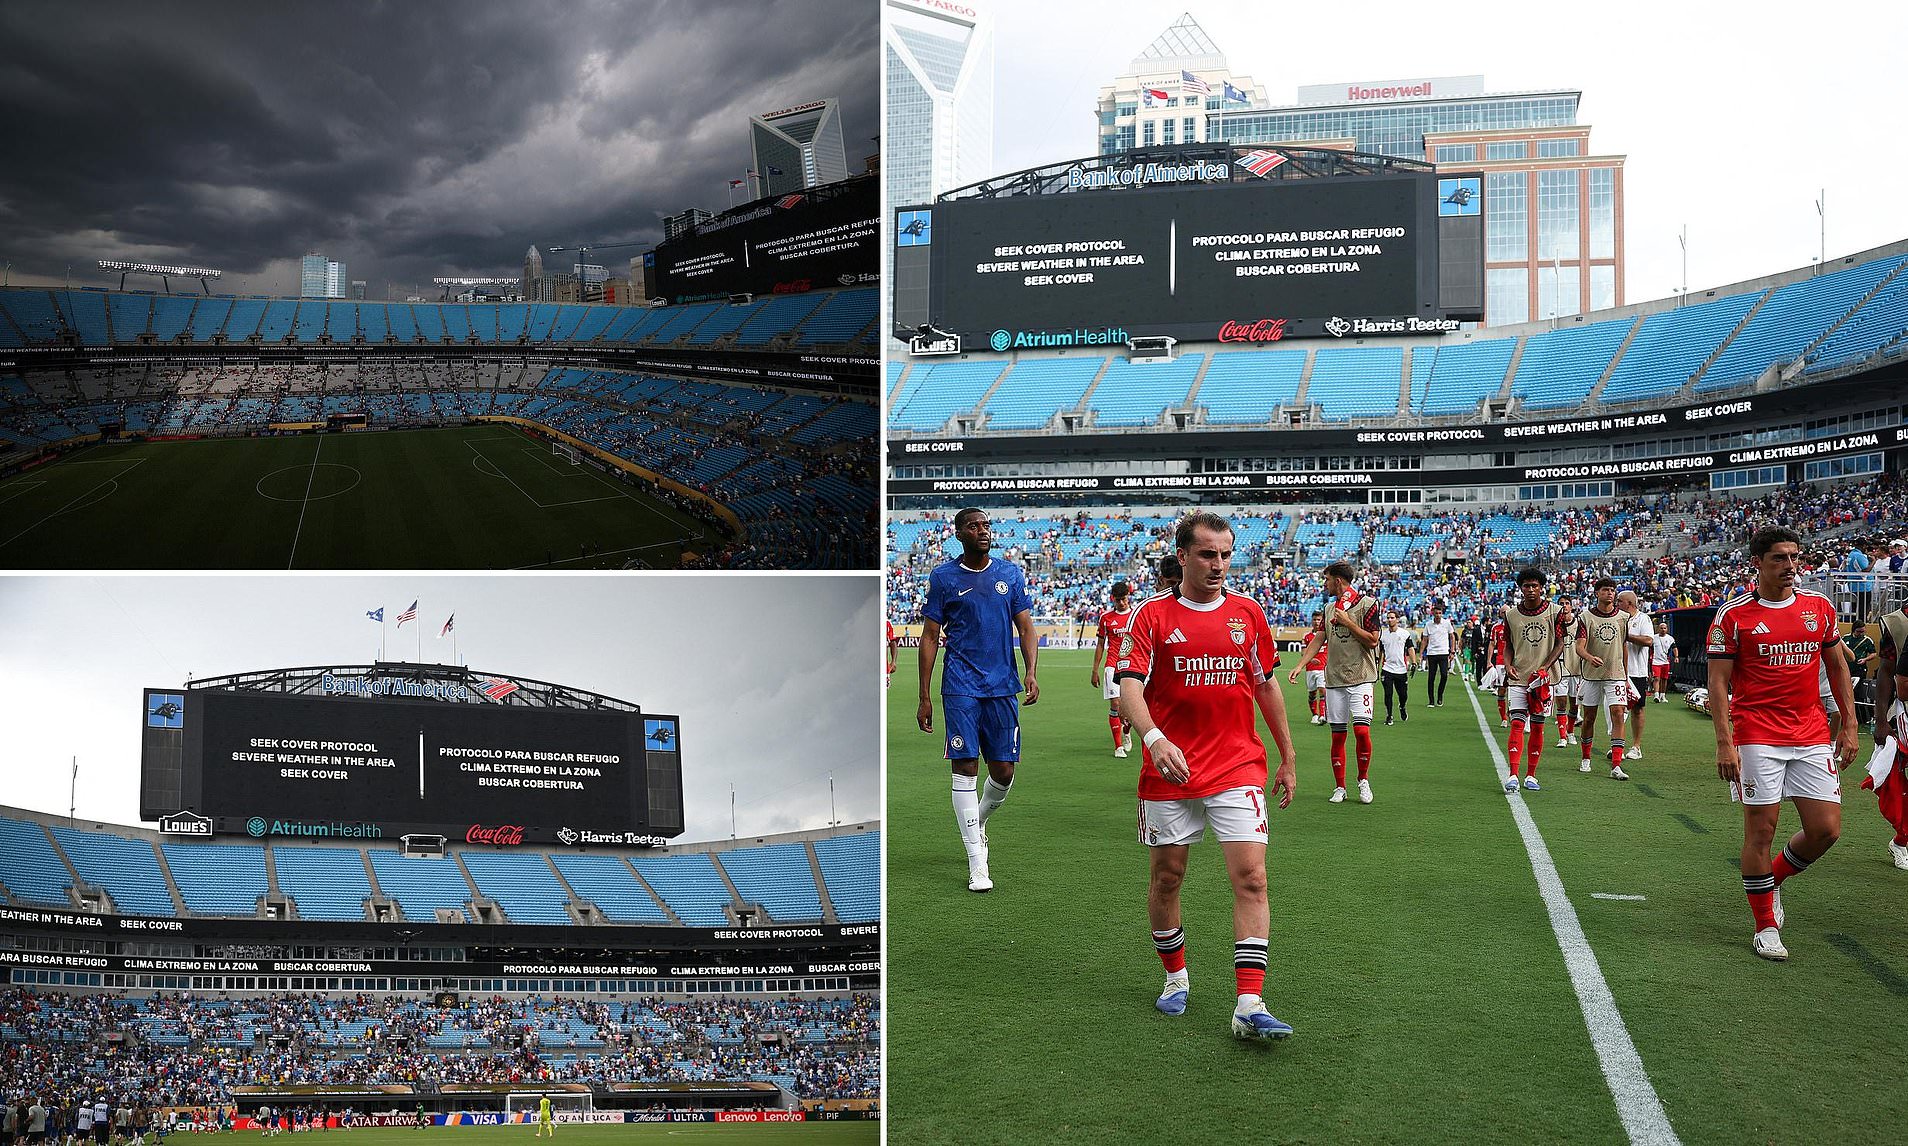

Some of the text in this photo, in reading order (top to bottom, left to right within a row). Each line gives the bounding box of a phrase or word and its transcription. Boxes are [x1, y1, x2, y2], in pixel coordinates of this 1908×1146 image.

[1348, 82, 1432, 100] Honeywell
[1068, 160, 1229, 188] Bank of America
[755, 225, 849, 250] PROTOCOLO PARA BUSCAR
[767, 247, 788, 255] CLIMA
[789, 239, 823, 251] EXTREMO
[849, 228, 875, 239] ZONA
[1192, 227, 1405, 247] PROTOCOLO PARA BUSCAR REFUGIO
[780, 241, 860, 261] BUSCAR COBERTURA
[994, 240, 1126, 257] SEEK COVER PROTOCOL
[1215, 244, 1381, 261] CLIMA EXTREMO EN LA ZONA
[976, 255, 1144, 274] SEVERE WEATHER IN THE AREA
[1236, 261, 1360, 277] BUSCAR COBERTURA
[1024, 273, 1094, 286] SEEK COVER
[1218, 319, 1287, 343] Coca-Cola
[1353, 318, 1460, 333] Harris Teeter
[1014, 328, 1129, 347] Atrium Health
[801, 355, 847, 364] SEEK COVER
[767, 370, 833, 381] BUSCAR COBERTURA
[1685, 401, 1752, 421] SEEK COVER
[1504, 413, 1667, 438] SEVERE WEATHER IN THE AREA
[1357, 430, 1485, 443] SEEK COVER PROTOCOL
[905, 442, 964, 453] SEEK COVER
[1730, 434, 1879, 463] CLIMA EXTREMO EN LA ZONA
[1525, 456, 1713, 479] PROTOCOLO PARA BUSCAR REFUGIO
[1266, 474, 1373, 485] BUSCAR COBERTURA
[1758, 639, 1820, 656] Emirates
[1174, 653, 1245, 672] Emirates
[1769, 653, 1812, 666] FLY BETTER
[322, 674, 468, 699] Bank of America
[1185, 671, 1237, 687] FLY BETTER
[1614, 685, 1626, 696] 83
[1363, 694, 1370, 706] 8
[250, 738, 378, 752] SEEK COVER PROTOCOL
[232, 752, 396, 768] SEVERE WEATHER IN THE AREA
[439, 747, 620, 764] PROTOCOLO PARA BUSCAR REFUGIO
[280, 768, 348, 780] SEEK COVER
[460, 762, 601, 777] CLIMA EXTREMO EN LA ZONA
[478, 777, 584, 790] BUSCAR COBERTURA
[164, 818, 207, 833] LOWE'S
[270, 820, 382, 838] Atrium Health
[465, 823, 525, 845] Coca-Cola
[581, 831, 667, 846] Harris Teeter
[41, 913, 103, 927] IN THE AREA
[120, 919, 183, 931] SEEK COVER
[714, 928, 824, 939] SEEK COVER PROTOCOL
[841, 926, 878, 935] SEVERE
[22, 954, 108, 967] BUSCAR REFUGIO
[124, 959, 259, 971] CLIMA EXTREMO EN LA ZONA
[274, 962, 372, 972] BUSCAR COBERTURA
[808, 962, 880, 973] BUSCAR COBER
[504, 964, 658, 975] PROTOCOLO PARA BUSCAR REFUGIO
[471, 1114, 497, 1125] VISA
[633, 1112, 705, 1122] Michelob ULTRA
[718, 1112, 757, 1122] Lenovo
[764, 1112, 802, 1121] Lenovo
[826, 1112, 839, 1120] PIF
